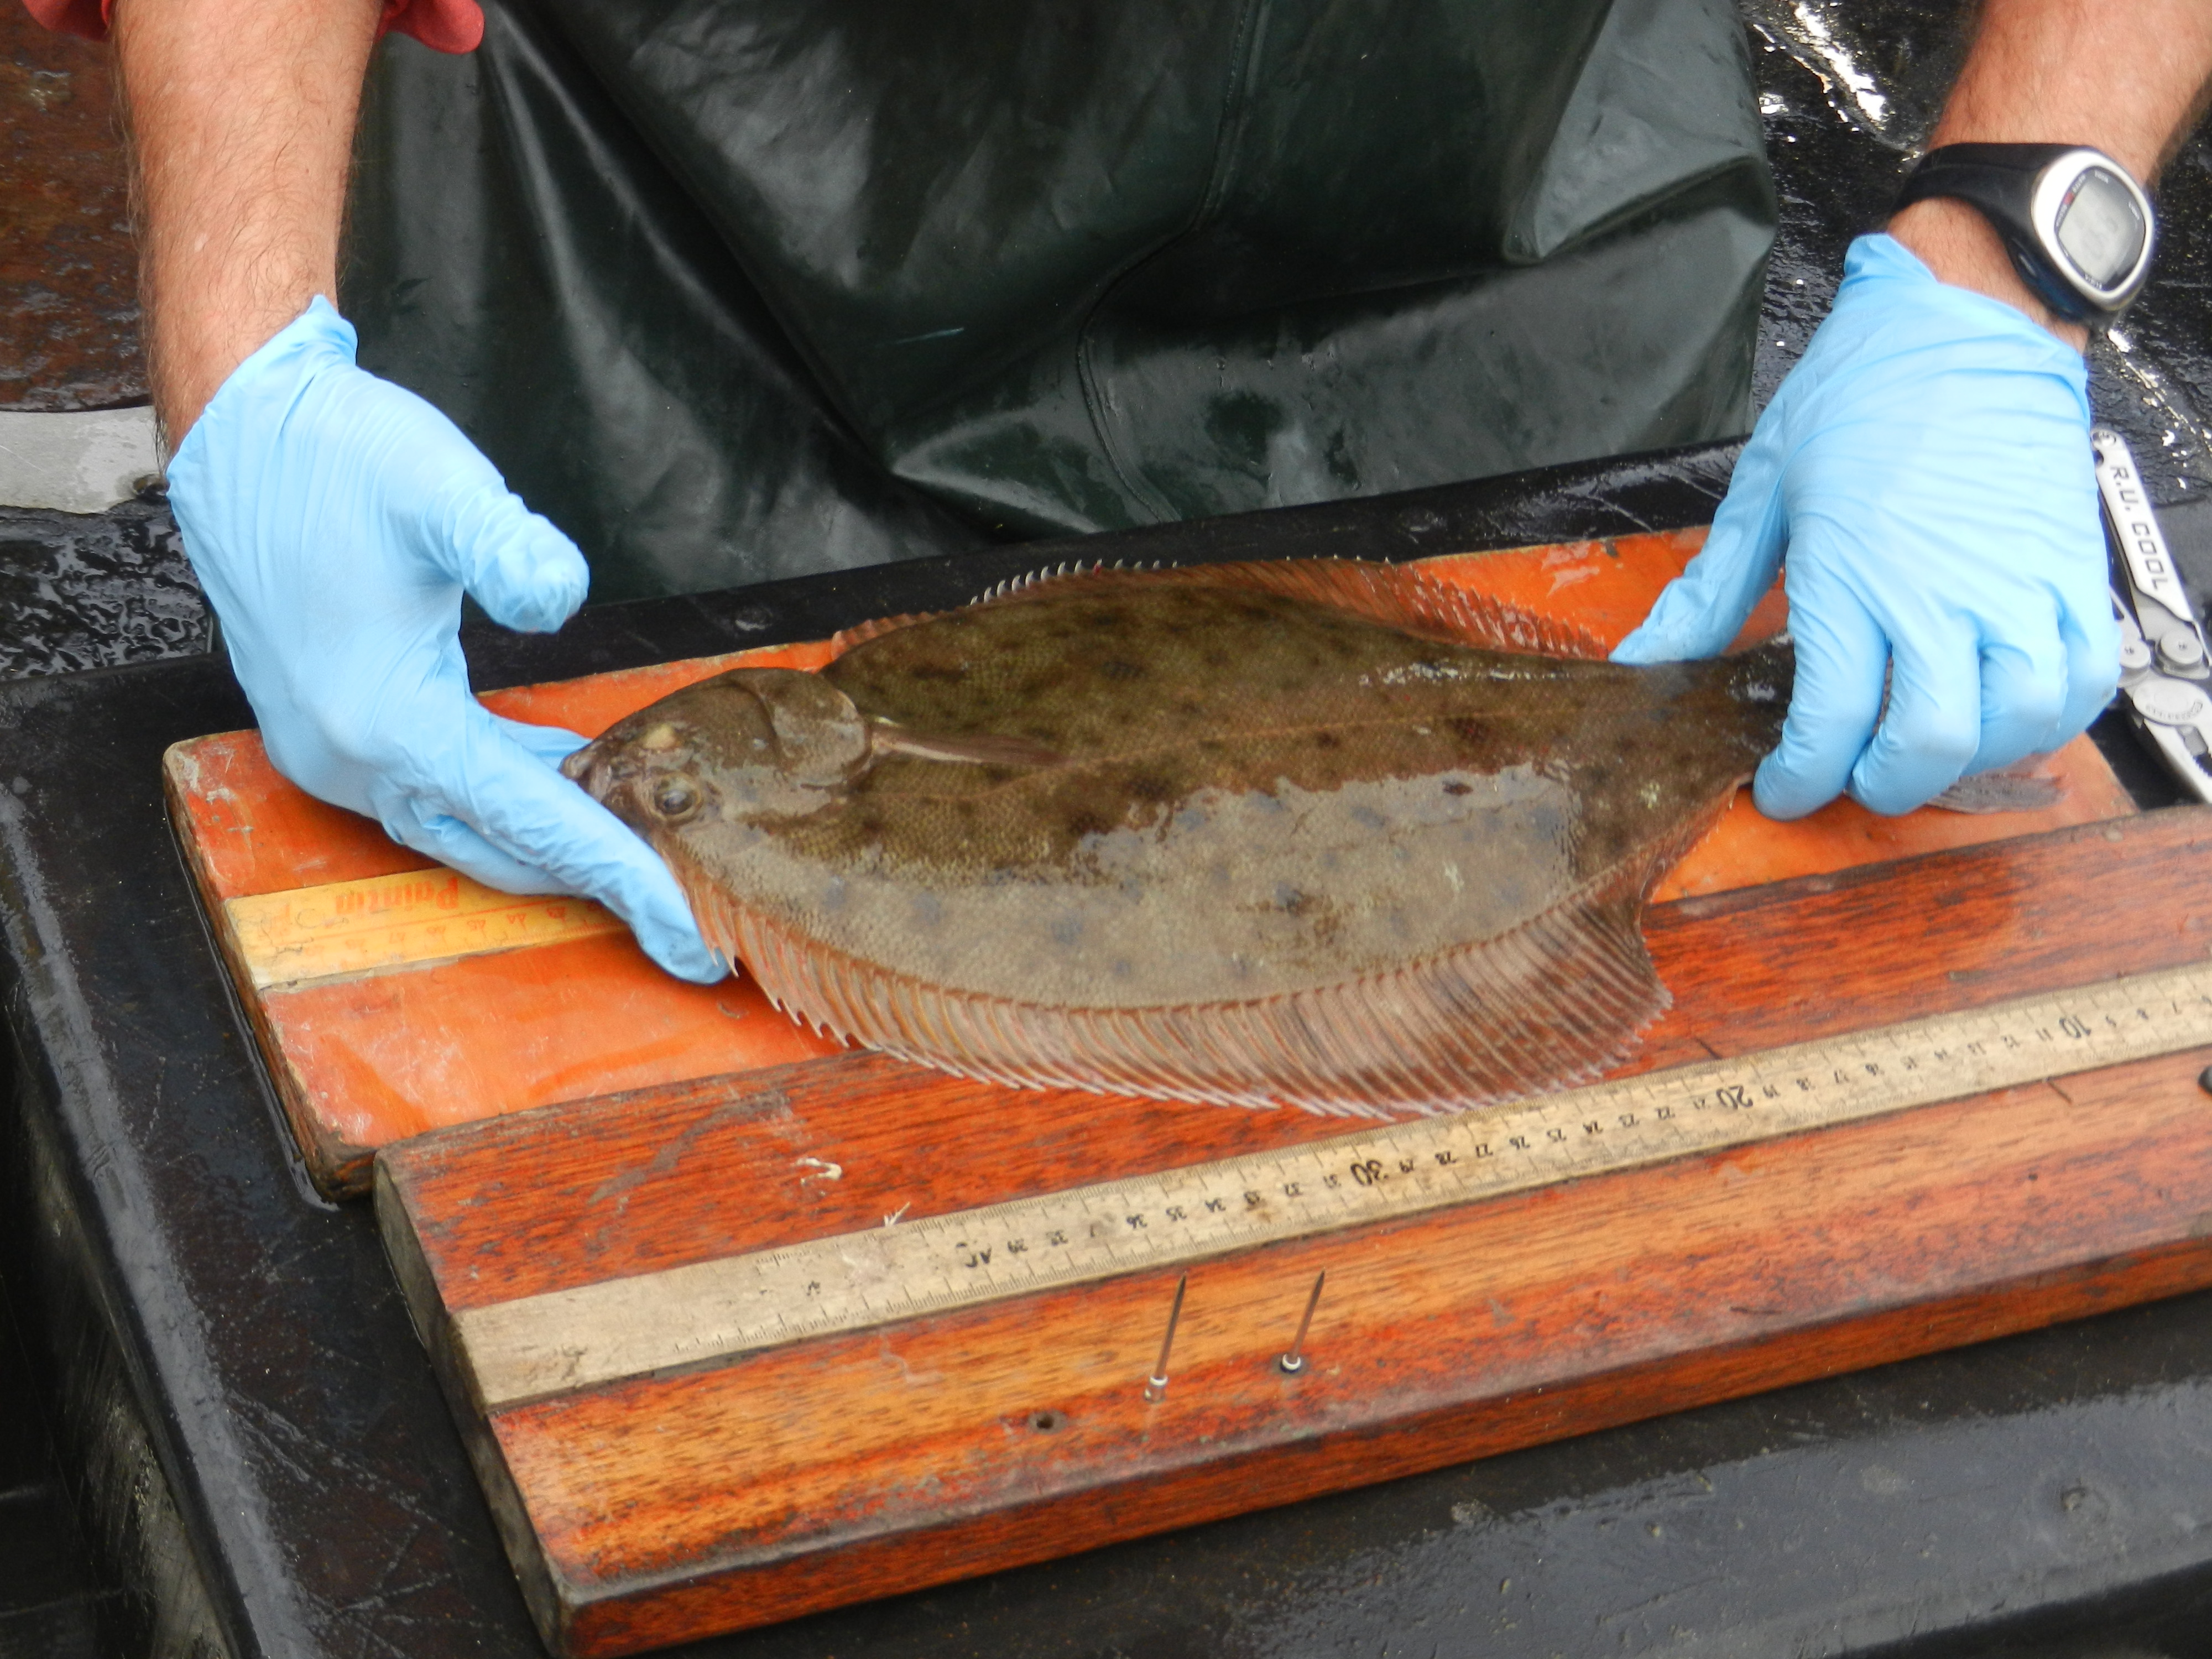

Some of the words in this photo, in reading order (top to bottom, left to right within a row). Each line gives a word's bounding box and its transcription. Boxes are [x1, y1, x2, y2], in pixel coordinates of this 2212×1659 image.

[2131, 521, 2168, 589] COOL
[467, 920, 486, 931] 45
[507, 914, 526, 924] 44
[1126, 1213, 1147, 1228] 36
[1166, 1206, 1187, 1222] 35
[1204, 1197, 1226, 1212] 34
[1243, 1191, 1261, 1206] 33
[1284, 1182, 1303, 1196] 32
[1350, 1159, 1389, 1186] 30
[1399, 1160, 1415, 1173] 29
[1435, 1150, 1457, 1165] 28
[1475, 1143, 1494, 1158] 27
[1509, 1136, 1530, 1150] 26
[1546, 1128, 1567, 1142] 25
[1583, 1120, 1603, 1134] 24
[1618, 1113, 1640, 1128] 23
[1658, 1107, 1676, 1121] 22
[1715, 1085, 1754, 1110] 20
[1763, 1084, 1781, 1098] 19
[1796, 1076, 1816, 1092] 18
[1834, 1069, 1850, 1084] 17
[2035, 1027, 2053, 1041] 11
[2058, 1014, 2091, 1039] 10
